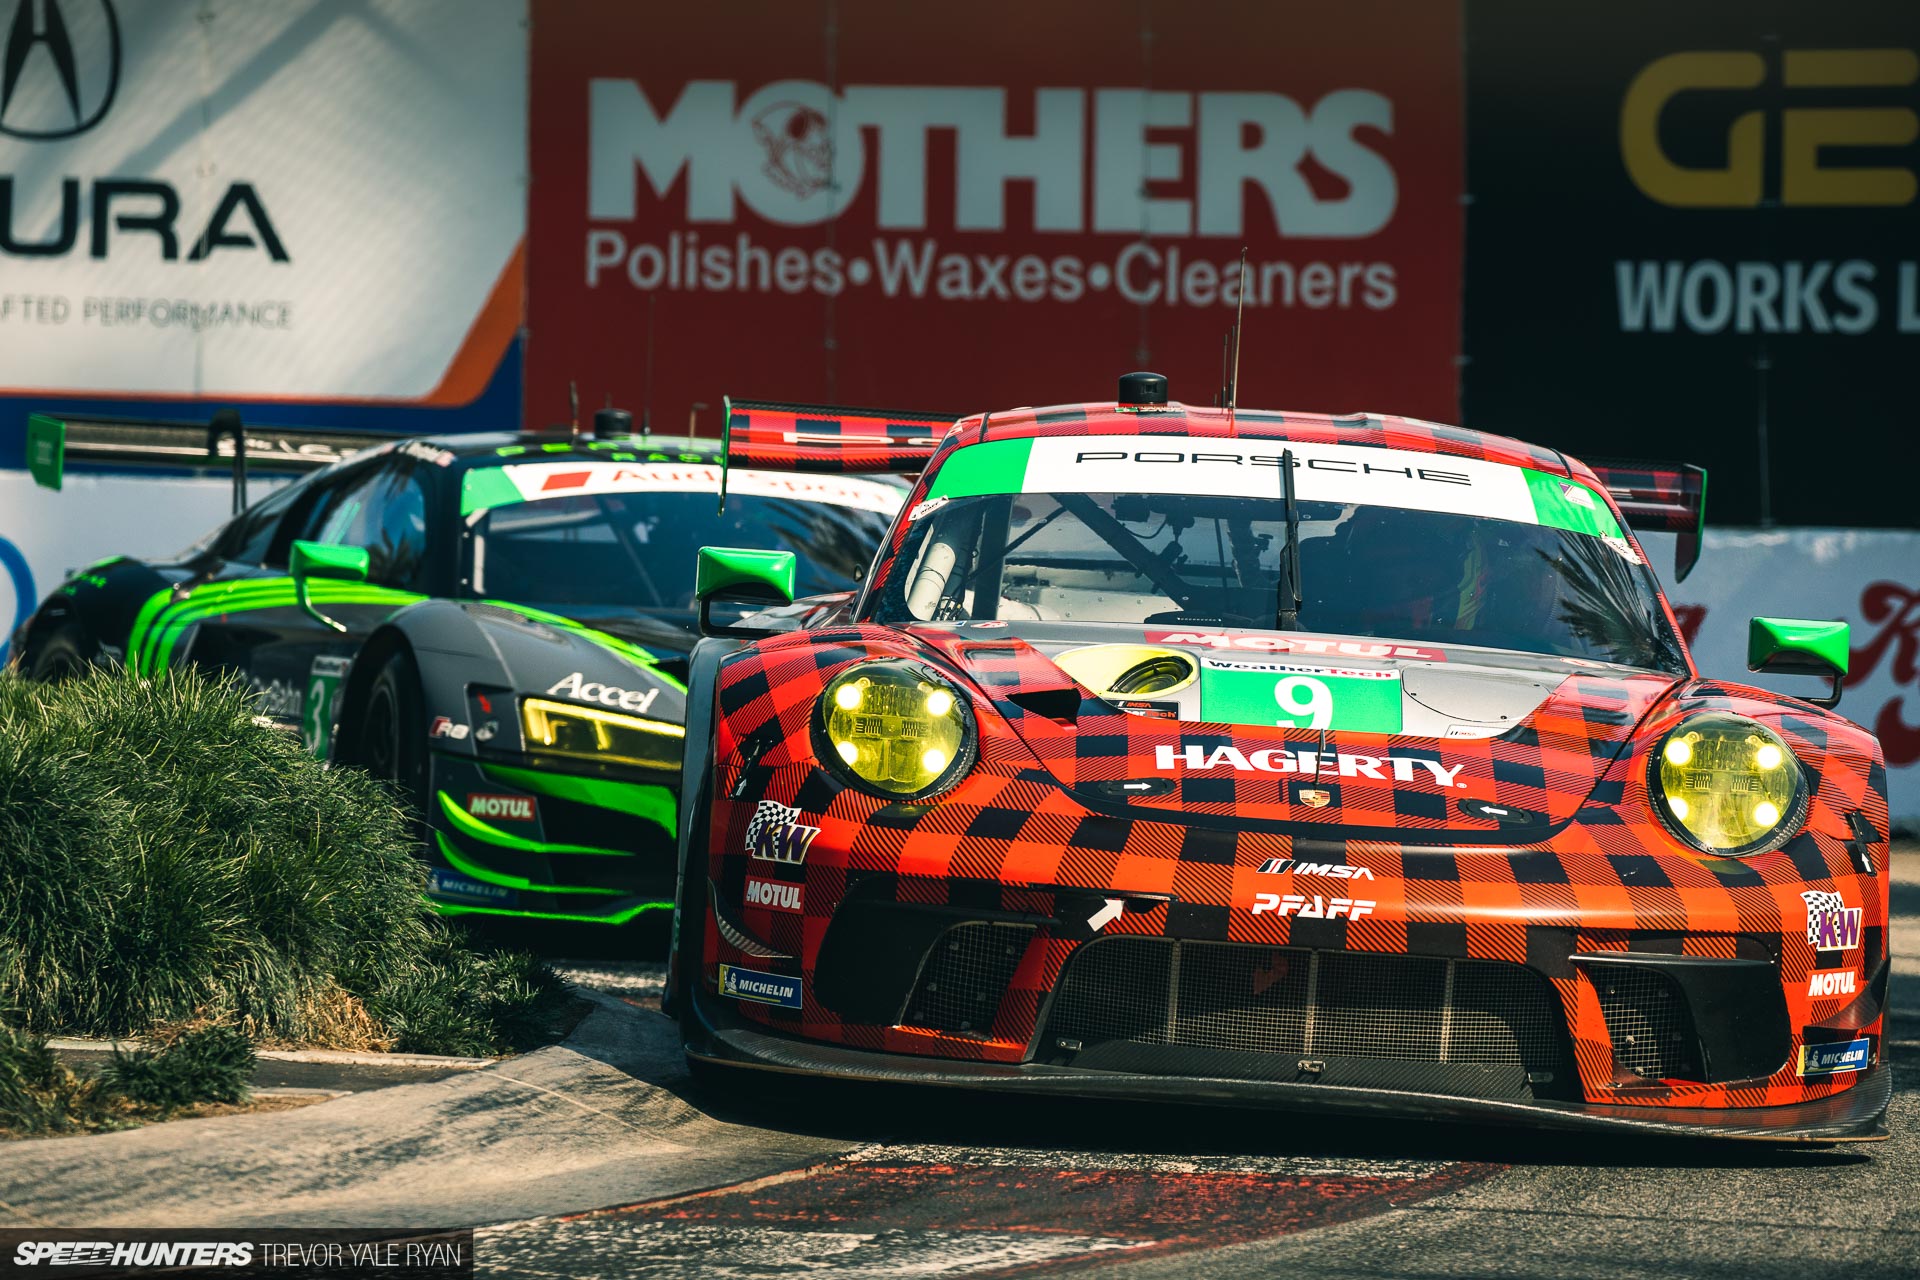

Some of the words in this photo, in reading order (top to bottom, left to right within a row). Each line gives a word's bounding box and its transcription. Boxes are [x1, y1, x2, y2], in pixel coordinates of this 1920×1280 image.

[588, 77, 1397, 238] MOTHERS
[0, 174, 291, 263] URA
[586, 229, 844, 296] Polishes
[874, 237, 1085, 302] Waxes
[1114, 242, 1397, 310] Cleaners
[1614, 259, 1879, 335] WORKS
[83, 296, 292, 330] PERFORMANCE
[612, 468, 729, 485] Aud
[1076, 452, 1471, 486] PORSCHE
[1160, 633, 1434, 660] MOTUL
[1208, 660, 1393, 679] WeatherTech
[546, 672, 659, 713] Accel
[1274, 675, 1333, 731] 9
[1155, 745, 1465, 788] HAGERTY
[470, 797, 532, 818] MOTUL
[1292, 862, 1375, 881] IMSA
[442, 879, 509, 897] MICHELIN
[747, 880, 801, 909] MOTUL
[1251, 893, 1377, 922] PFAFF
[738, 979, 794, 998] MICHELIN
[1808, 971, 1856, 997] MOTUL
[1821, 1049, 1865, 1065] MICHELIN
